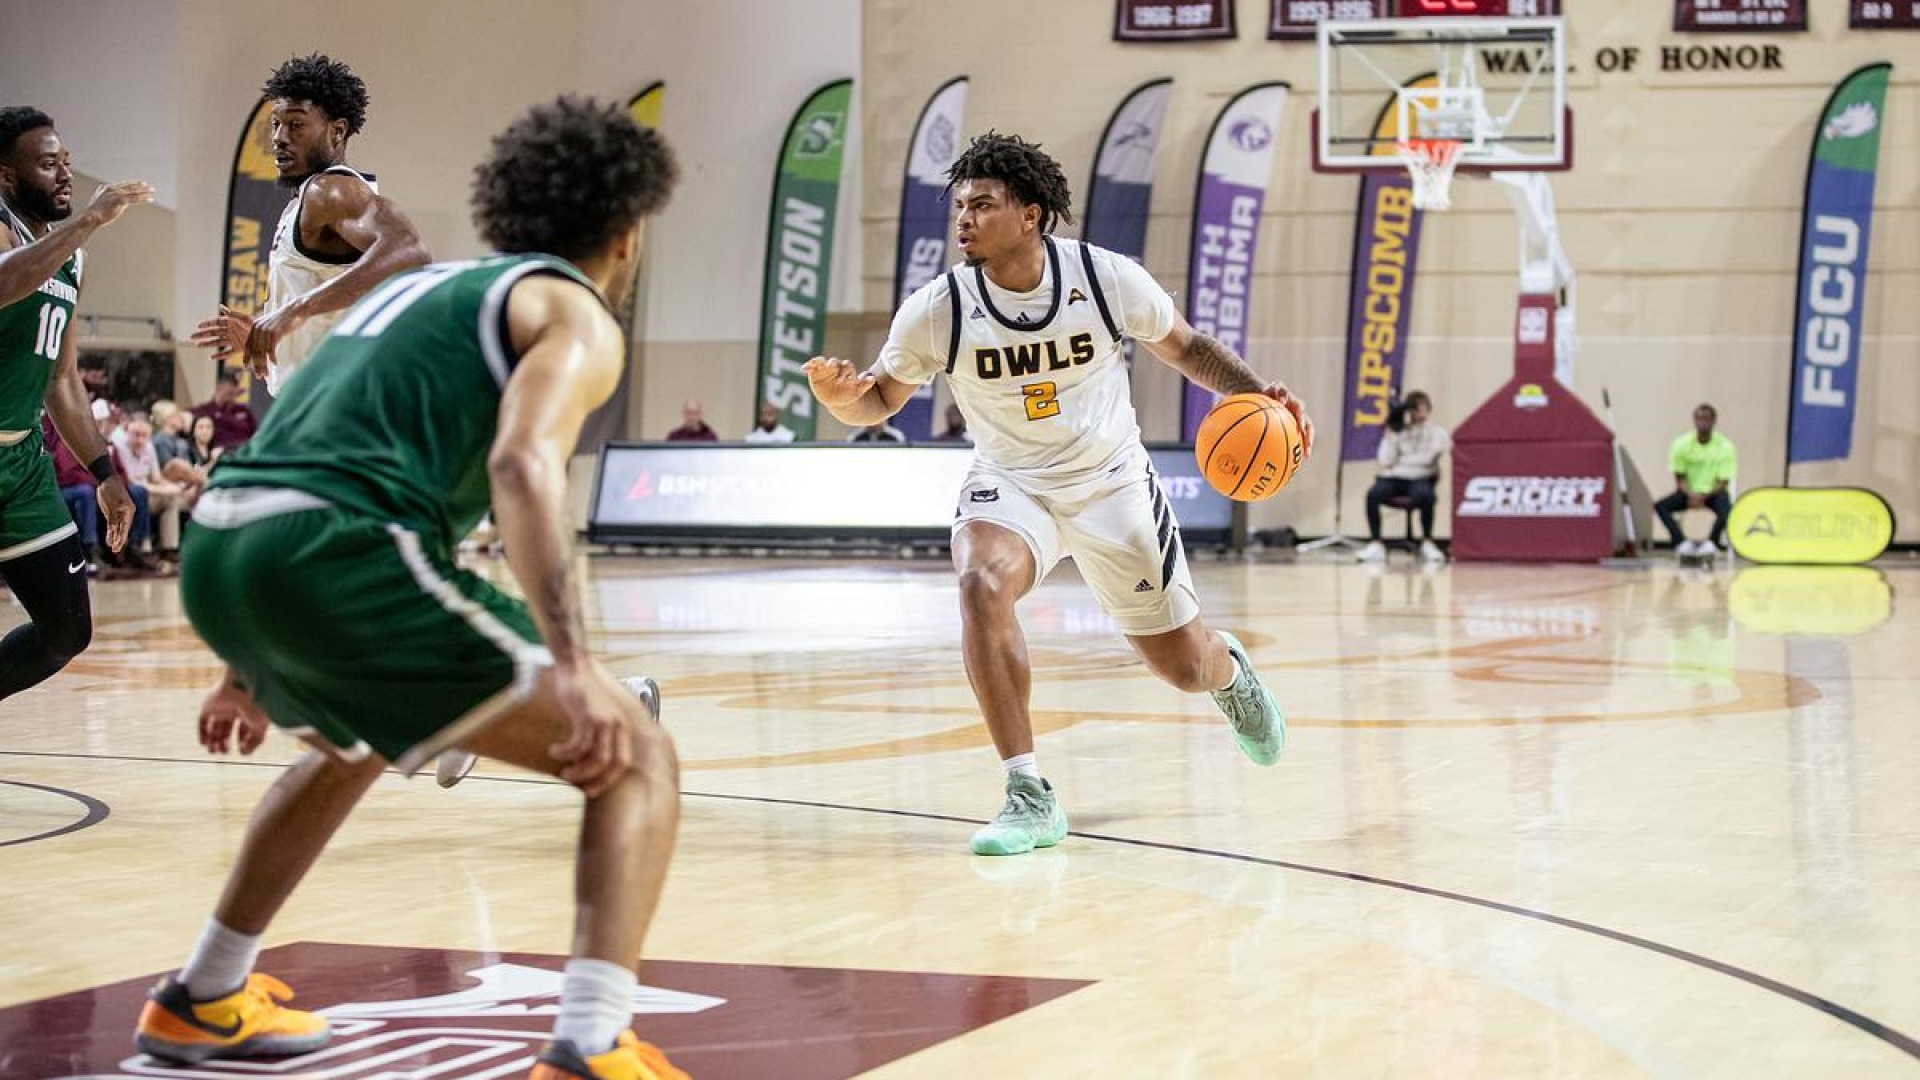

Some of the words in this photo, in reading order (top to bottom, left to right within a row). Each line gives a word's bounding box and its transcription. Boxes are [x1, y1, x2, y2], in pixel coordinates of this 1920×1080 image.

[1481, 49, 1576, 72] WA
[1596, 48, 1639, 71] OF
[1660, 46, 1782, 71] HONOR
[35, 302, 67, 361] 10
[332, 260, 450, 336] 11
[764, 197, 825, 417] STETSON
[1354, 185, 1412, 427] LIPSCOMB
[1803, 215, 1859, 406] FGCU
[975, 332, 1095, 380] OWLS
[1021, 380, 1061, 421] 2
